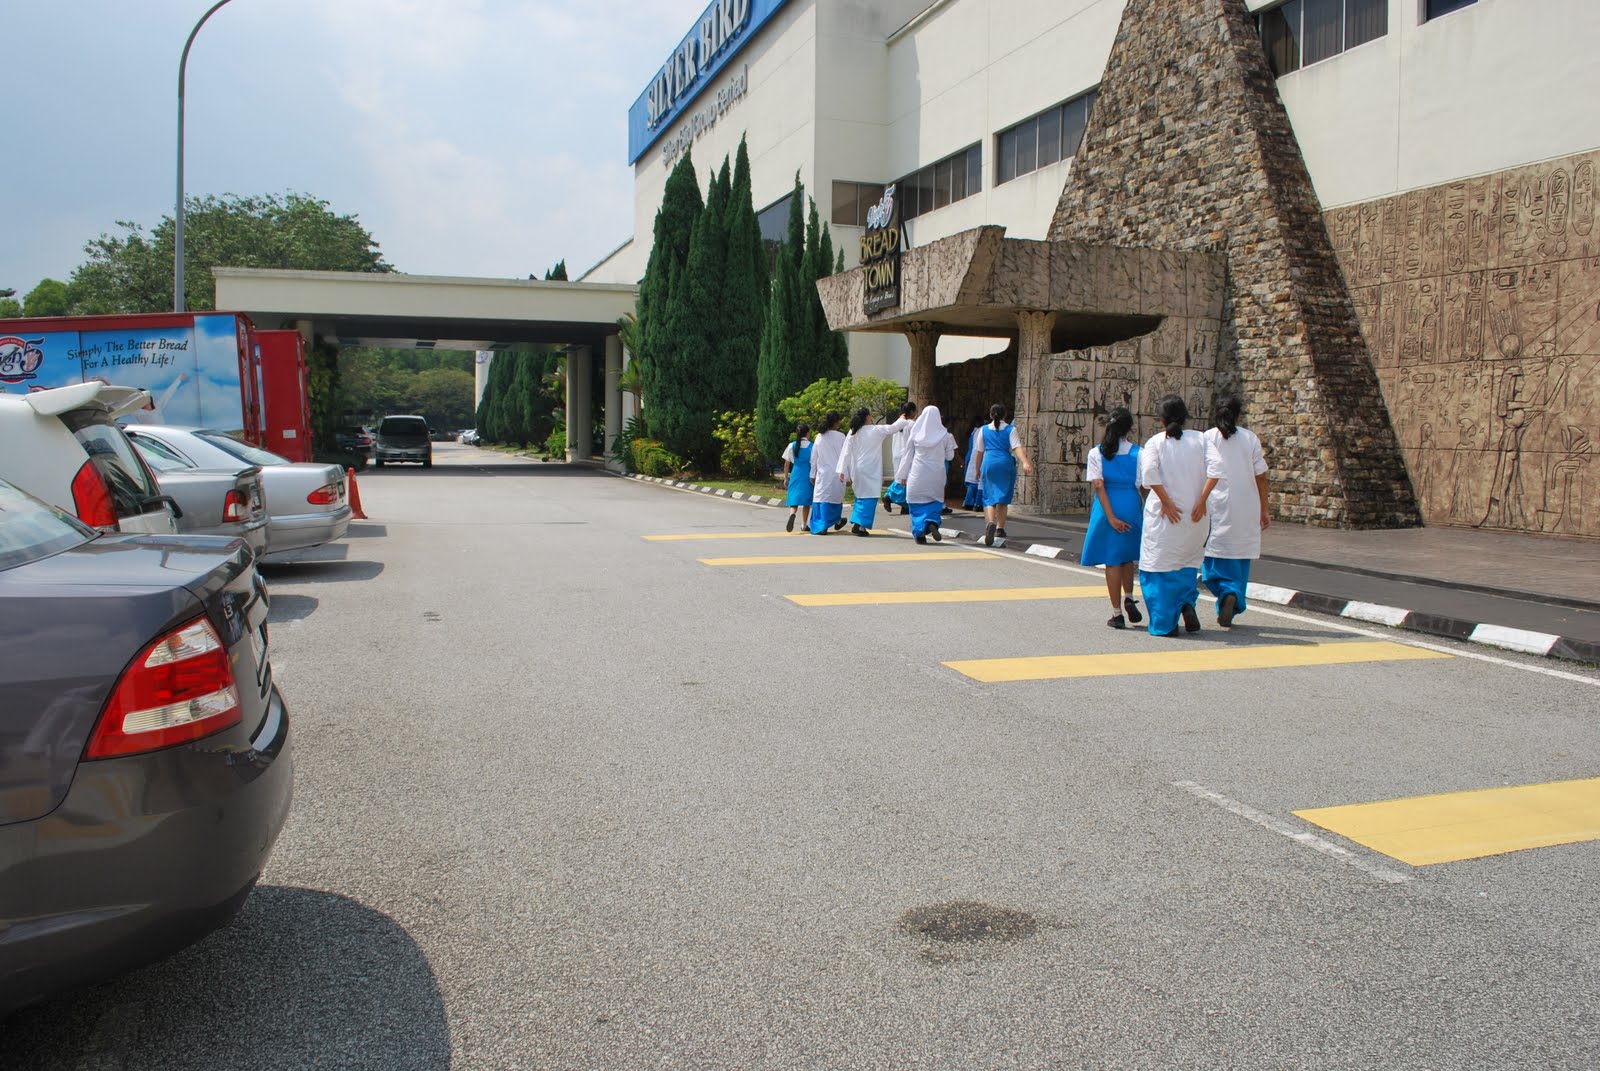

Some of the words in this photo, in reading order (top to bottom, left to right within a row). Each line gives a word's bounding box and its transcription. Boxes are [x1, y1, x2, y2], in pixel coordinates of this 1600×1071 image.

[647, 37, 697, 131] SILVER
[700, 0, 750, 71] BIRD
[860, 228, 898, 260] BREAD
[863, 261, 894, 290] TOWN
[67, 344, 102, 361] Simply
[105, 341, 124, 352] The
[127, 338, 156, 350] Better
[158, 338, 189, 351] Bread
[83, 360, 98, 370] For
[101, 356, 108, 367] A
[112, 353, 148, 367] Healthy
